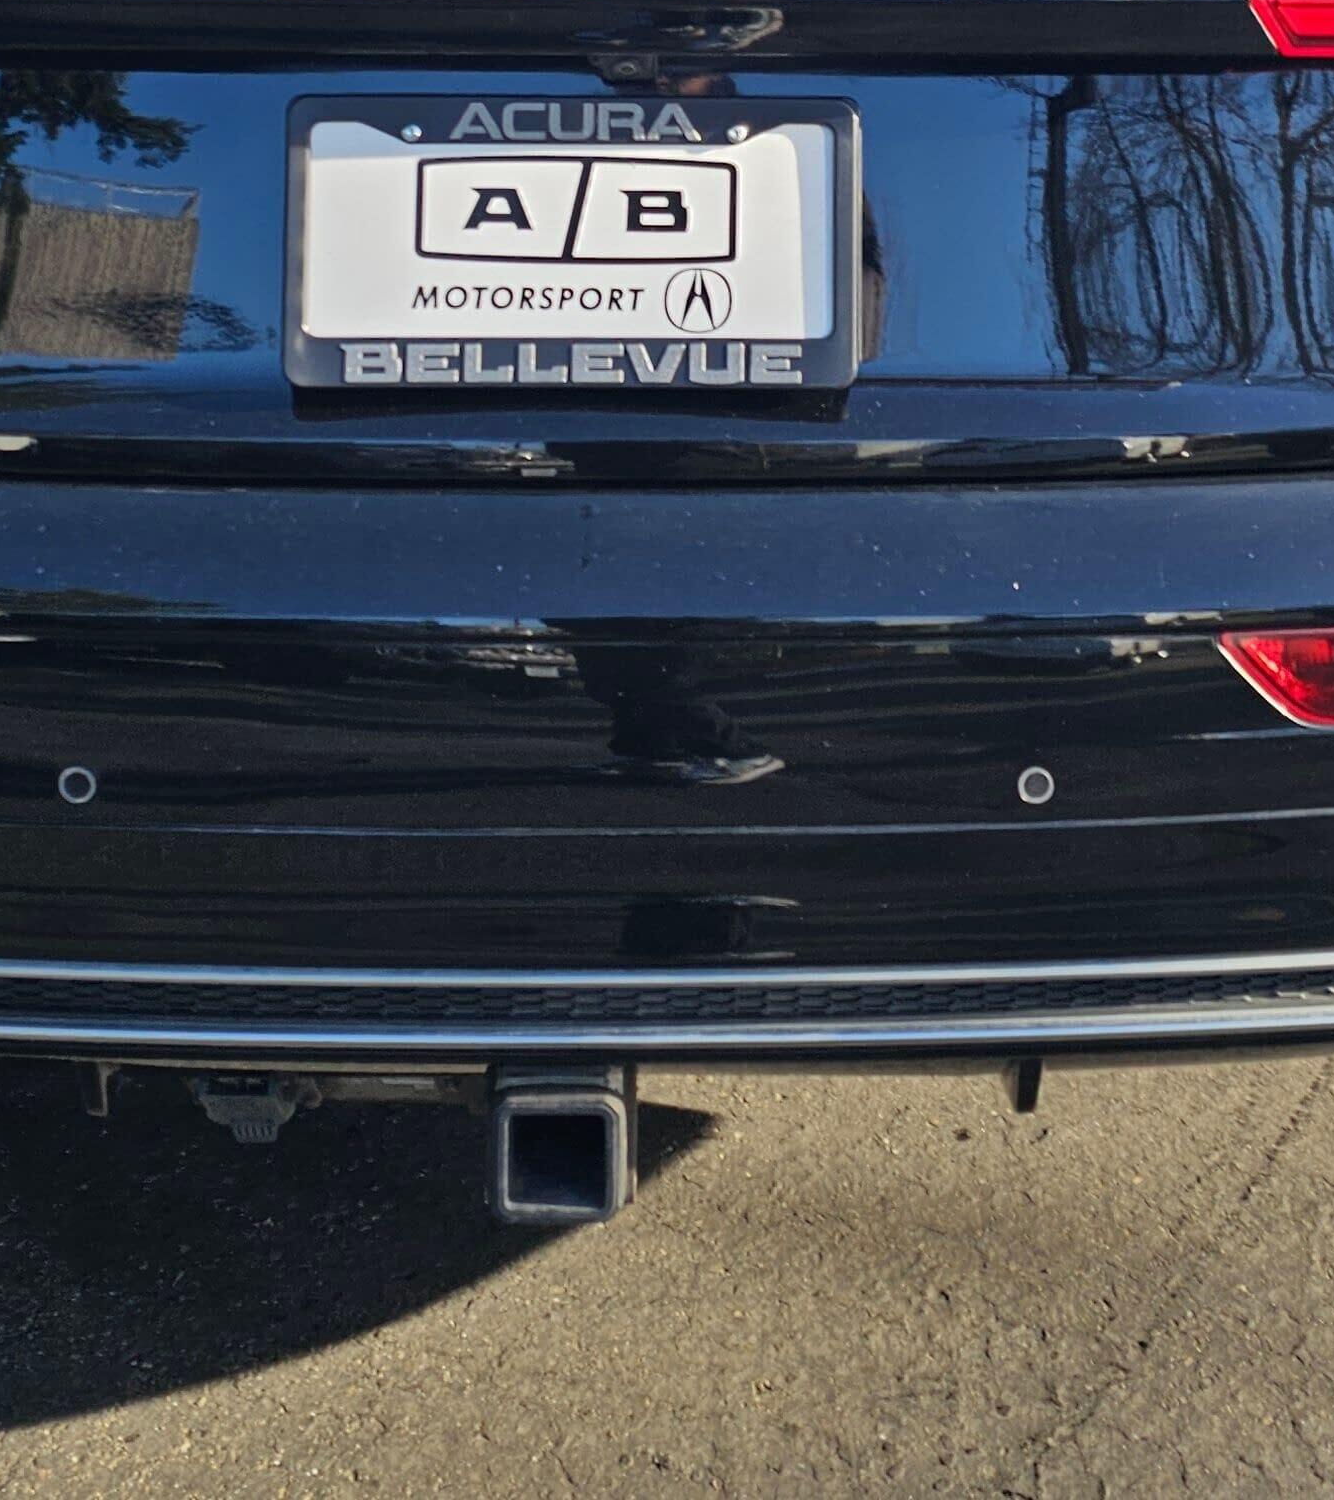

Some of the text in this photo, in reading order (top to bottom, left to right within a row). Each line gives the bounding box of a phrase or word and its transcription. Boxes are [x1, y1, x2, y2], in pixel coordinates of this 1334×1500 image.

[449, 101, 703, 143] ACURA
[411, 285, 646, 311] MOTORSPORT
[339, 342, 803, 385] BELLEVUE
